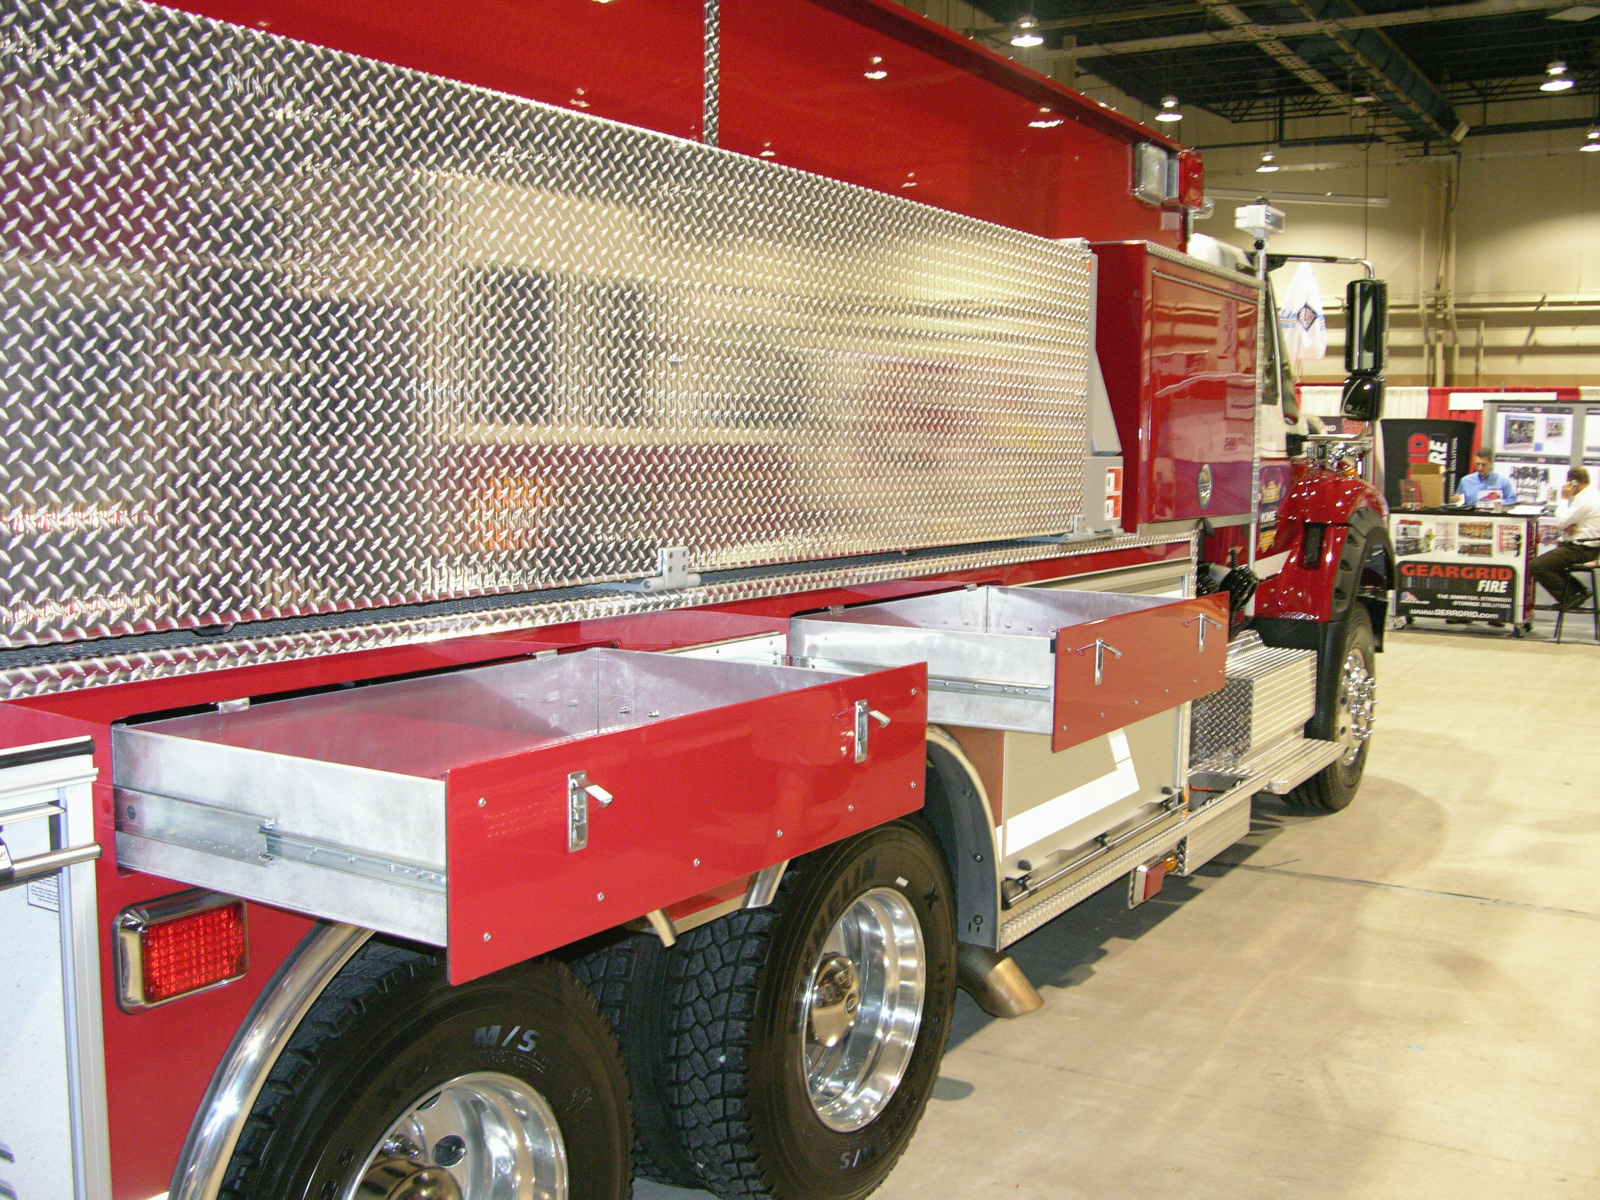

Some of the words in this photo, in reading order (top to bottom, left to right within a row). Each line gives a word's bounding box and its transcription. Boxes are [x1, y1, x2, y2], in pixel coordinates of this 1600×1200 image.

[1401, 563, 1513, 580] GEARGRID
[1477, 580, 1508, 593] FIRE
[474, 1025, 540, 1052] M/S
